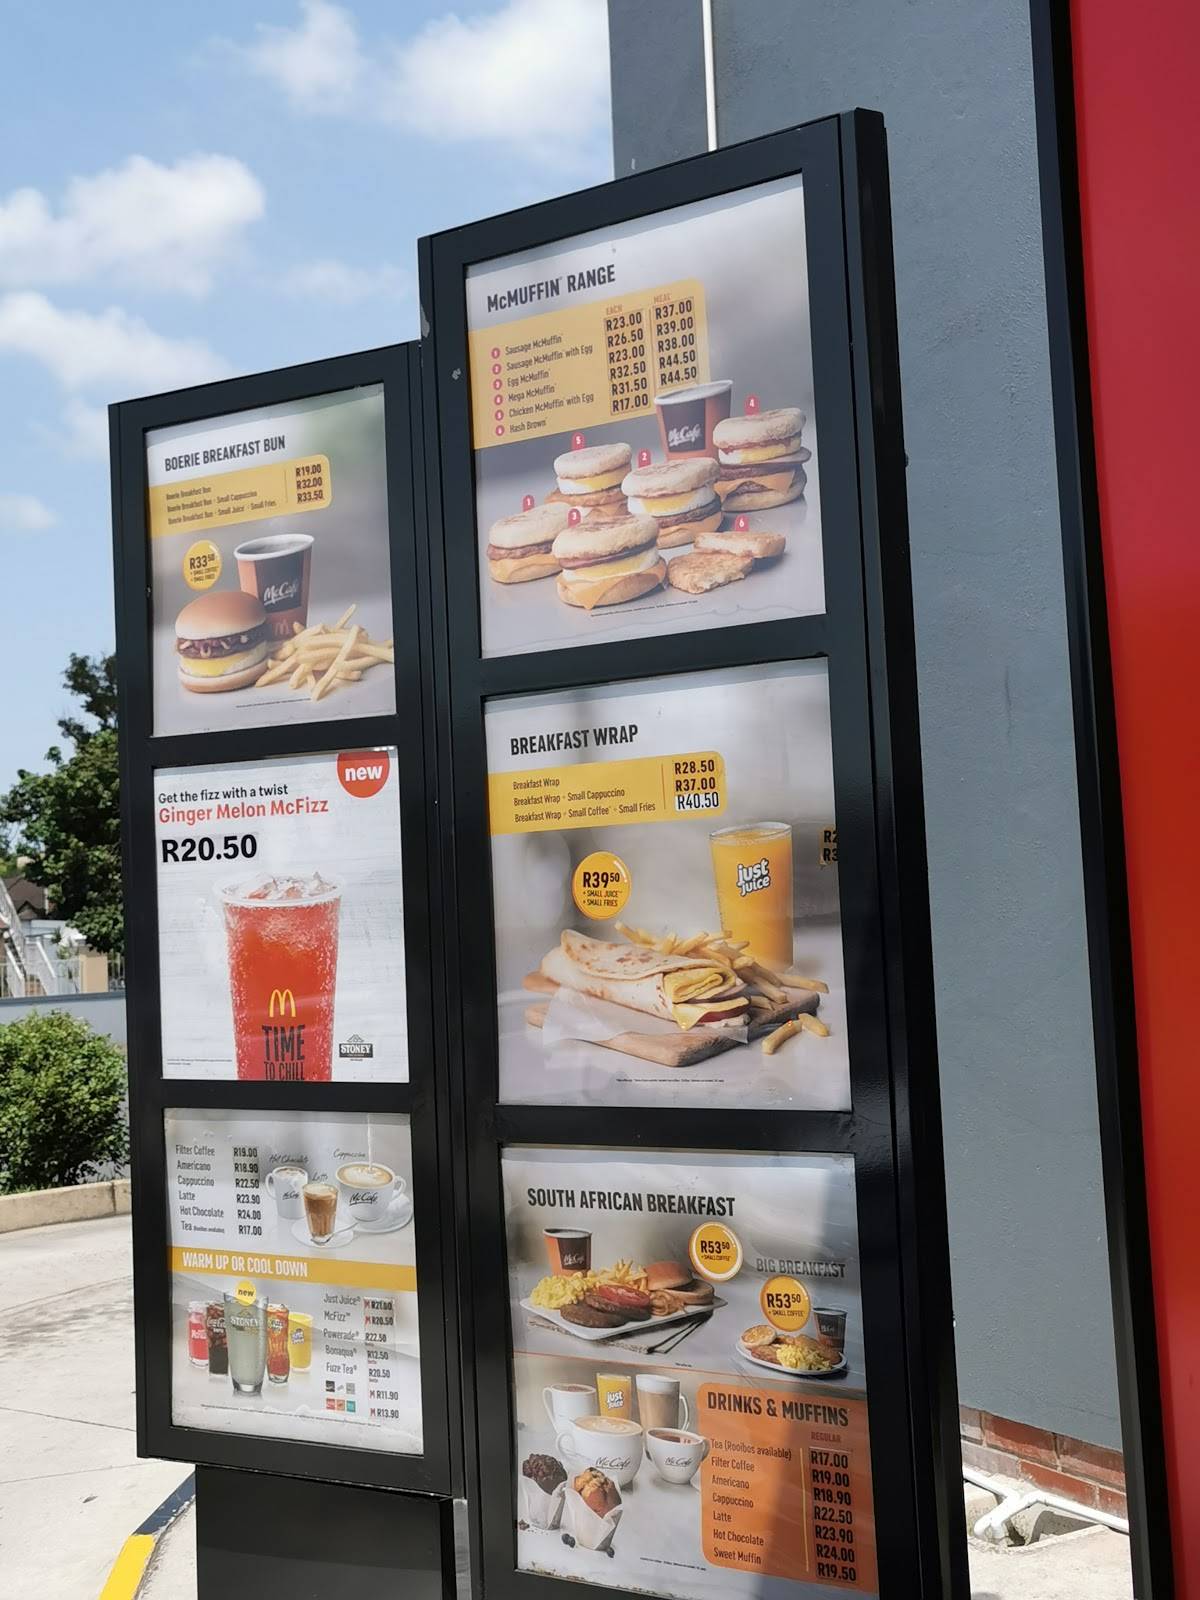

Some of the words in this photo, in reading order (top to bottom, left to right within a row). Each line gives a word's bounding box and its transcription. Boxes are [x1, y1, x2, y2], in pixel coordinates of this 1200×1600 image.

[487, 278, 560, 312] McMUFFIN
[568, 265, 615, 292] RANGE
[655, 300, 692, 320] R37.00
[606, 312, 642, 331] R23.00
[657, 317, 693, 336] R39.00
[505, 344, 531, 355] Sausage
[533, 335, 561, 348] McMuffin
[608, 328, 643, 348] R26.50
[658, 333, 694, 352] R38.00
[507, 359, 532, 370] Sausage
[534, 351, 562, 364] McMuffin
[565, 347, 579, 356] with
[581, 345, 592, 354] Egg
[609, 345, 644, 364] R23.00
[659, 350, 695, 369] R44.50
[508, 378, 518, 387] Egg
[520, 370, 549, 382] McMuffin
[610, 361, 646, 380] R32.50
[661, 366, 696, 386] R44.50
[508, 393, 524, 402] Mega
[526, 385, 554, 398] McMuffin
[612, 378, 647, 396] R31.50
[509, 406, 533, 417] Chicken
[535, 400, 564, 412] McMuffin
[566, 396, 580, 405] with
[582, 393, 594, 403] Egg
[613, 394, 648, 412] R17.00
[749, 398, 755, 407] 4
[510, 421, 525, 432] Hash
[527, 420, 546, 430] Brown
[576, 436, 581, 445] 5
[165, 452, 200, 471] BOERIE
[203, 441, 260, 463] BREAKFAST
[264, 435, 285, 452] BUN
[642, 452, 647, 461] 2
[296, 464, 321, 477] R19.00
[296, 477, 322, 490] R32.00
[297, 490, 323, 504] R33.50
[739, 519, 744, 527] 6
[511, 730, 590, 755] BREAKFAST
[594, 724, 638, 746] WRAP
[345, 765, 382, 781] new
[674, 760, 714, 774] R28.50
[513, 780, 542, 790] Breakfast
[544, 778, 560, 788] Wrap
[675, 777, 716, 792] R37.00
[159, 793, 178, 804] Get
[180, 791, 198, 802] the
[200, 788, 220, 801] fizz
[223, 787, 247, 799] with
[250, 789, 256, 797] a
[259, 784, 288, 796] twist
[514, 796, 543, 806] Breakfast
[544, 794, 560, 804] Wrap
[568, 791, 585, 801] Small
[587, 788, 625, 800] Cappuccino
[677, 792, 719, 809] R40.50
[159, 806, 212, 825] Ginger
[217, 803, 266, 820] Melon
[270, 797, 328, 816] McFizz
[515, 813, 544, 822] Breakfast
[545, 811, 561, 821] Wrap
[569, 808, 586, 818] Small
[588, 806, 609, 816] Coffee
[619, 804, 637, 813] Small
[639, 802, 656, 812] Fries
[162, 834, 257, 862] R20.50
[737, 858, 769, 885] just
[740, 876, 770, 897] juice
[262, 1025, 305, 1061] TIME
[341, 1044, 370, 1054] STONEY
[264, 1062, 274, 1080] TO
[279, 1062, 305, 1080] CHILL
[176, 1145, 192, 1154] Filter
[194, 1146, 215, 1156] Coffee
[234, 1148, 257, 1157] R19.00
[177, 1160, 211, 1171] Americano
[234, 1163, 258, 1173] R18.90
[178, 1176, 214, 1187] Cappuccino
[236, 1178, 259, 1188] R22.50
[179, 1191, 195, 1200] Latte
[237, 1194, 260, 1204] R23.90
[527, 1188, 575, 1209] SOUTH
[580, 1190, 642, 1211] AFRICAN
[647, 1193, 735, 1216] BREAKFAST
[180, 1206, 192, 1216] Hot
[192, 1206, 224, 1217] Chocolate
[238, 1210, 261, 1220] R24.00
[181, 1221, 192, 1230] Tea
[239, 1225, 262, 1235] R17.00
[182, 1252, 213, 1268] WARM
[216, 1255, 228, 1270] UP
[232, 1256, 244, 1272] OR
[247, 1258, 273, 1275] COOL
[275, 1261, 307, 1277] DOWN
[757, 1258, 776, 1273] BIG
[780, 1260, 845, 1278] BREAKFAST
[238, 1289, 254, 1297] new
[372, 1317, 393, 1325] R20.50
[366, 1333, 386, 1342] R22.50
[368, 1350, 388, 1359] R12.50
[326, 1362, 340, 1373] Fuze
[369, 1369, 390, 1378] R20.50
[377, 1391, 398, 1400] R11.90
[377, 1408, 399, 1418] R13.90
[708, 1392, 762, 1415] DRINKS
[767, 1399, 777, 1417] &
[782, 1401, 848, 1427] MUFFINS
[812, 1432, 841, 1443] REGULAR
[711, 1439, 722, 1449] Tea
[725, 1441, 755, 1454] (Rooibos
[757, 1445, 792, 1460] available)
[712, 1457, 730, 1468] Filter
[732, 1459, 754, 1472] Coffee
[812, 1451, 848, 1468] R17.00
[712, 1475, 750, 1489] Americano
[812, 1469, 849, 1487] R19.00
[712, 1493, 754, 1508] Cappuccino
[814, 1488, 851, 1505] R18.90
[713, 1511, 732, 1522] Latte
[814, 1506, 852, 1524] R22.50
[713, 1529, 726, 1540] Hot
[728, 1532, 764, 1546] Chocolate
[815, 1525, 853, 1544] R23.90
[714, 1548, 736, 1560] Sweet
[738, 1552, 761, 1564] Muffin
[816, 1544, 854, 1562] R24.00
[818, 1563, 856, 1581] R19.50
